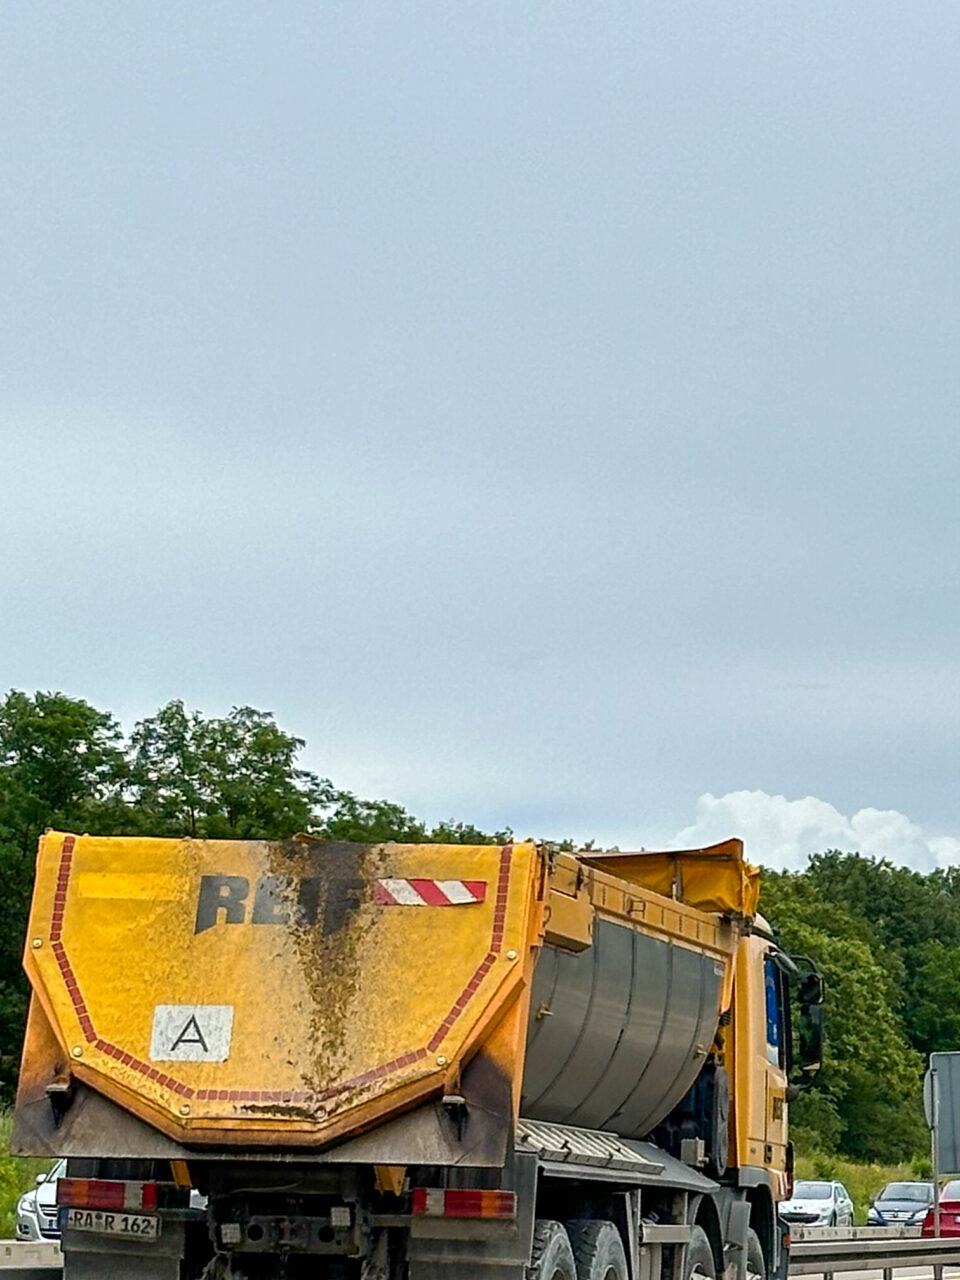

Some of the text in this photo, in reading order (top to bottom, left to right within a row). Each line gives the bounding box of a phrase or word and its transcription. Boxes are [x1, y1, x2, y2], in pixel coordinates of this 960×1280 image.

[170, 1014, 208, 1052] A
[73, 1211, 152, 1235] RA R 162
